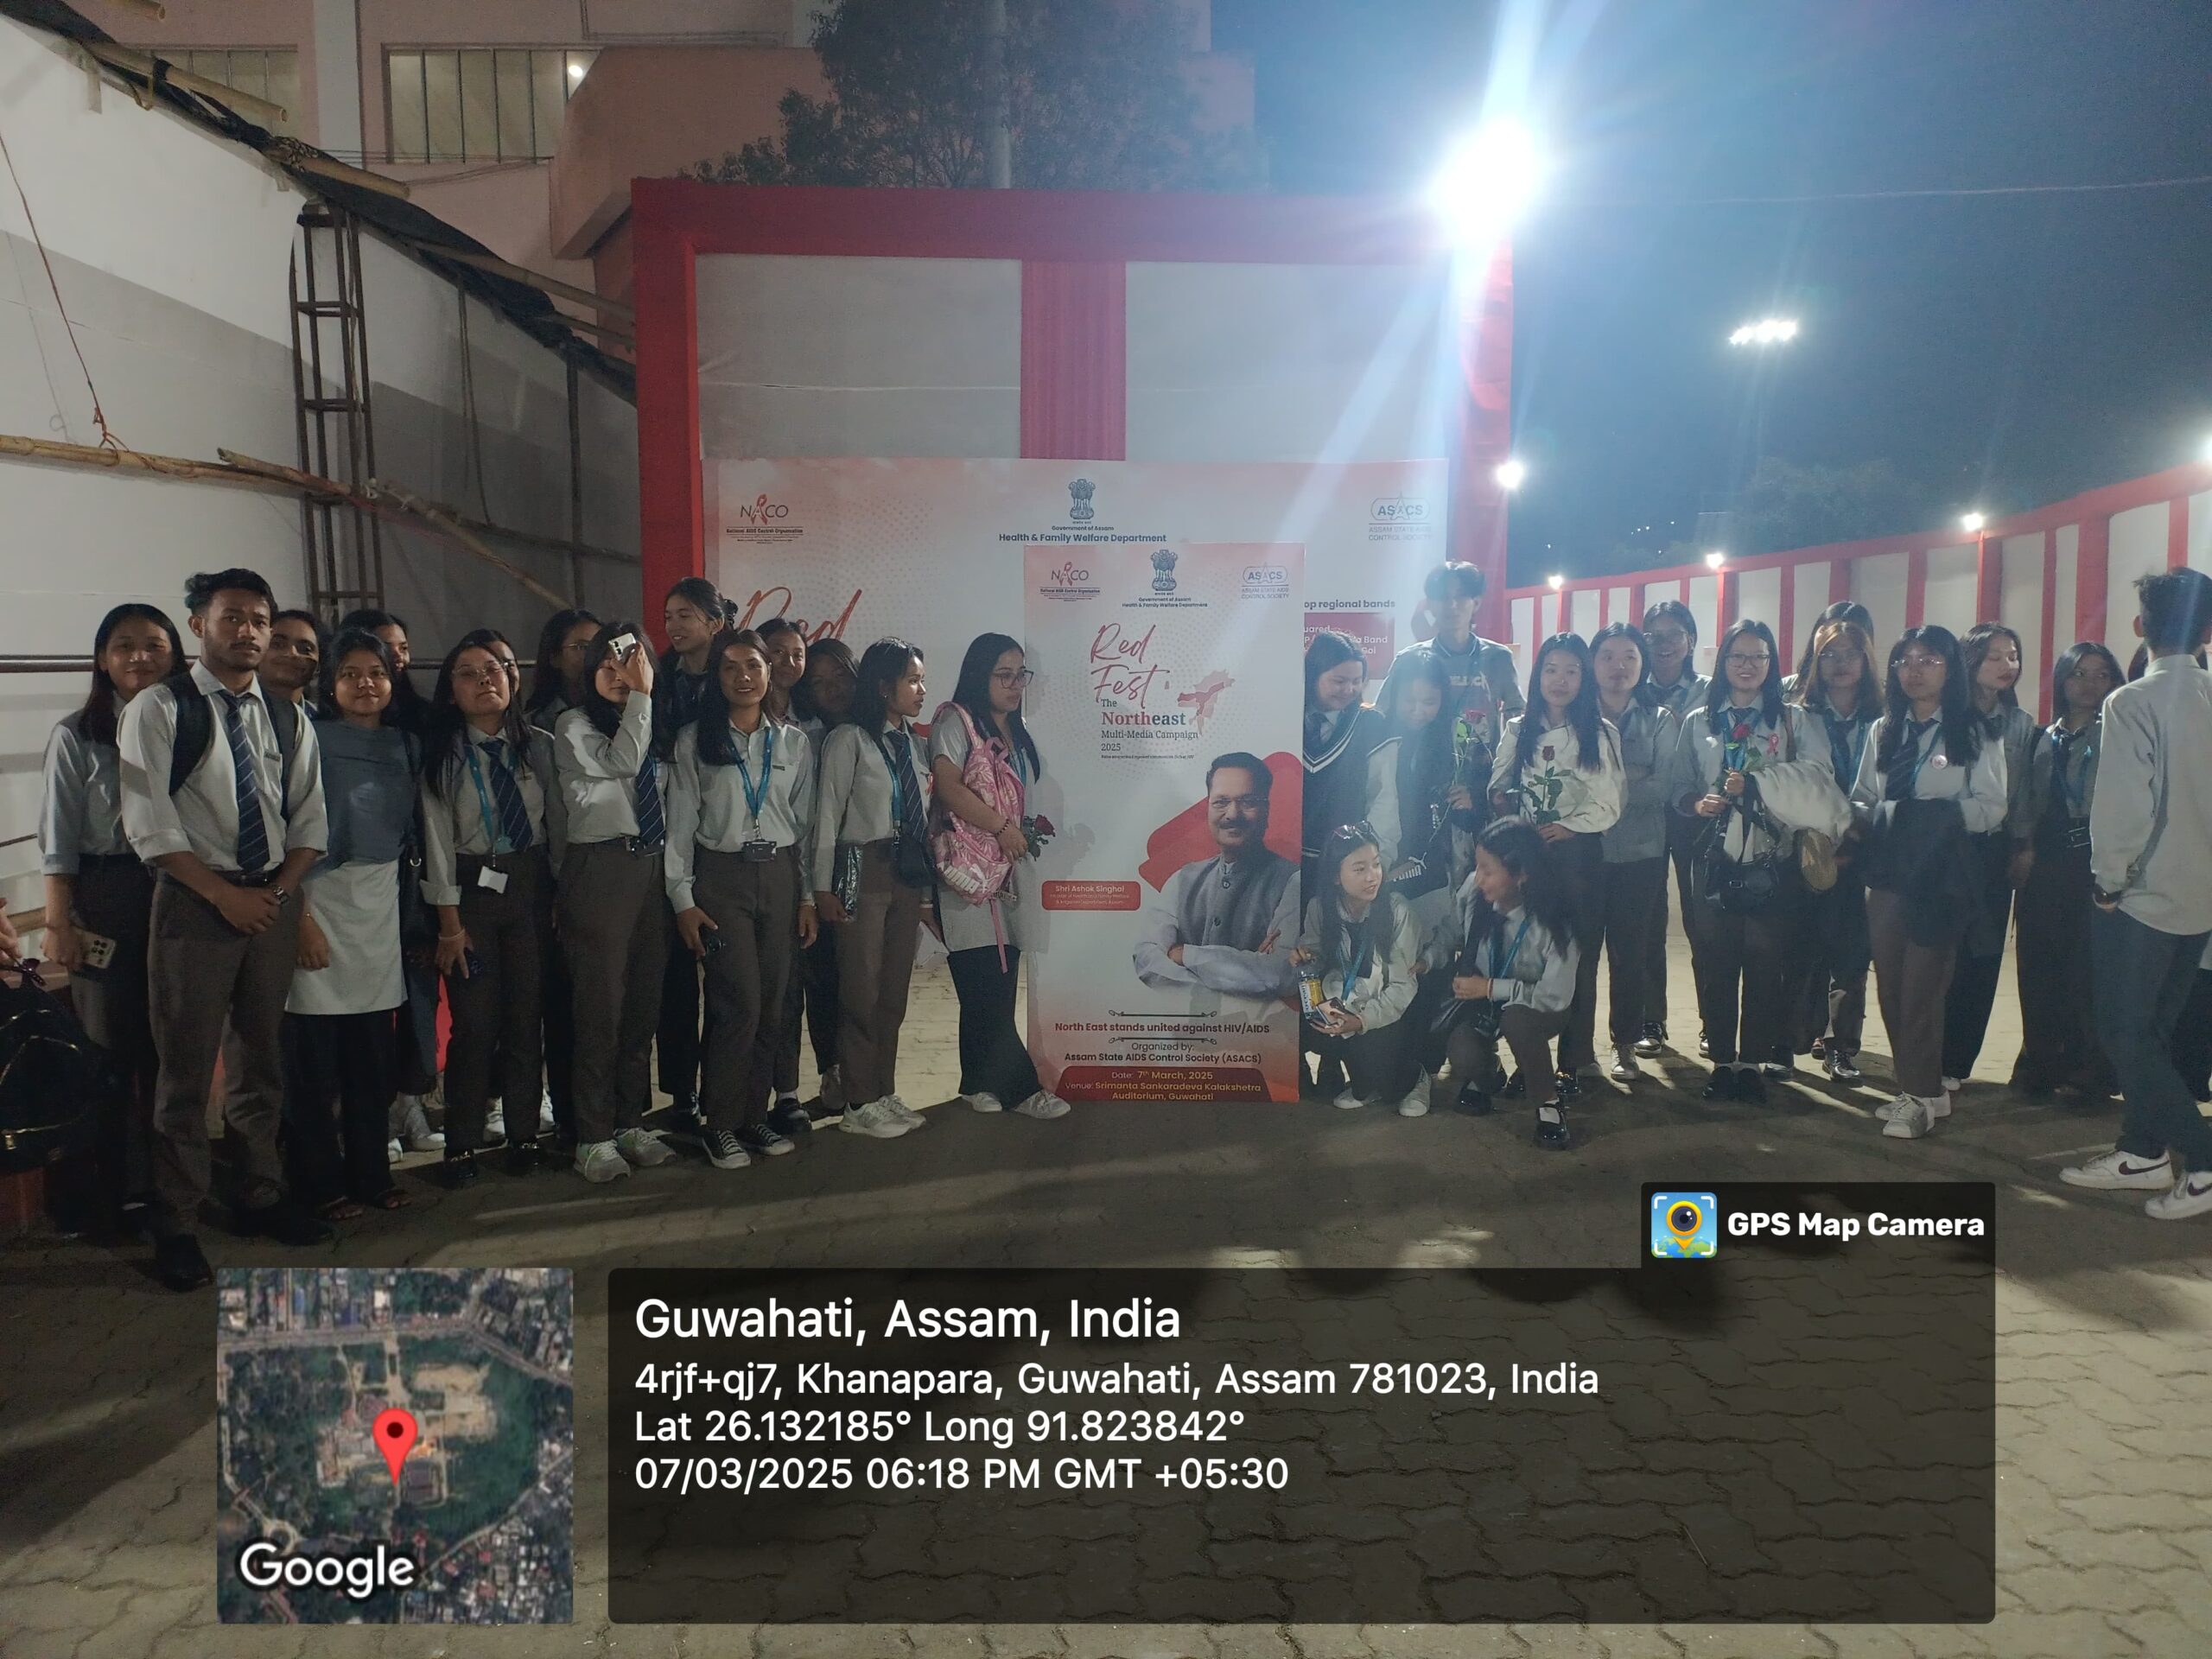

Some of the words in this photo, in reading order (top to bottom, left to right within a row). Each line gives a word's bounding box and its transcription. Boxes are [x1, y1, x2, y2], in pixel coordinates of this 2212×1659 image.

[999, 533, 1030, 542] Health
[1039, 533, 1071, 543] Family
[1073, 533, 1109, 543] Welfare
[1110, 534, 1167, 543] Department
[1319, 599, 1362, 610] regional
[1363, 600, 1395, 608] bands
[1090, 623, 1156, 664] Red
[1090, 664, 1171, 709] Fest
[1101, 698, 1117, 708] The
[1102, 711, 1186, 726] Northeast
[1101, 729, 1154, 739] Multi-Media
[1155, 730, 1198, 741] Campaign
[1101, 743, 1121, 752] 2025
[1055, 1022, 1084, 1031] North
[1085, 1022, 1108, 1031] East
[1109, 1022, 1145, 1032] stands
[1147, 1023, 1180, 1032] united
[1182, 1023, 1222, 1034] against
[1224, 1022, 1270, 1034] HIV/AIDS
[1131, 1042, 1179, 1052] Organized
[1065, 1053, 1096, 1062] Assam
[1098, 1053, 1123, 1062] State
[1125, 1053, 1147, 1062] AIDS
[1148, 1053, 1183, 1062] Control
[1185, 1053, 1219, 1064] Society
[1222, 1052, 1262, 1065] (ASACS)
[1151, 1071, 1186, 1080] March,
[1188, 1071, 1213, 1080] 2025
[1095, 1081, 1138, 1090] Srimanta
[1140, 1082, 1203, 1090] Sankaradeva
[1205, 1083, 1262, 1092] Kalakshetra
[1112, 1092, 1166, 1101] Auditorium,
[1168, 1092, 1214, 1101] Guwahati
